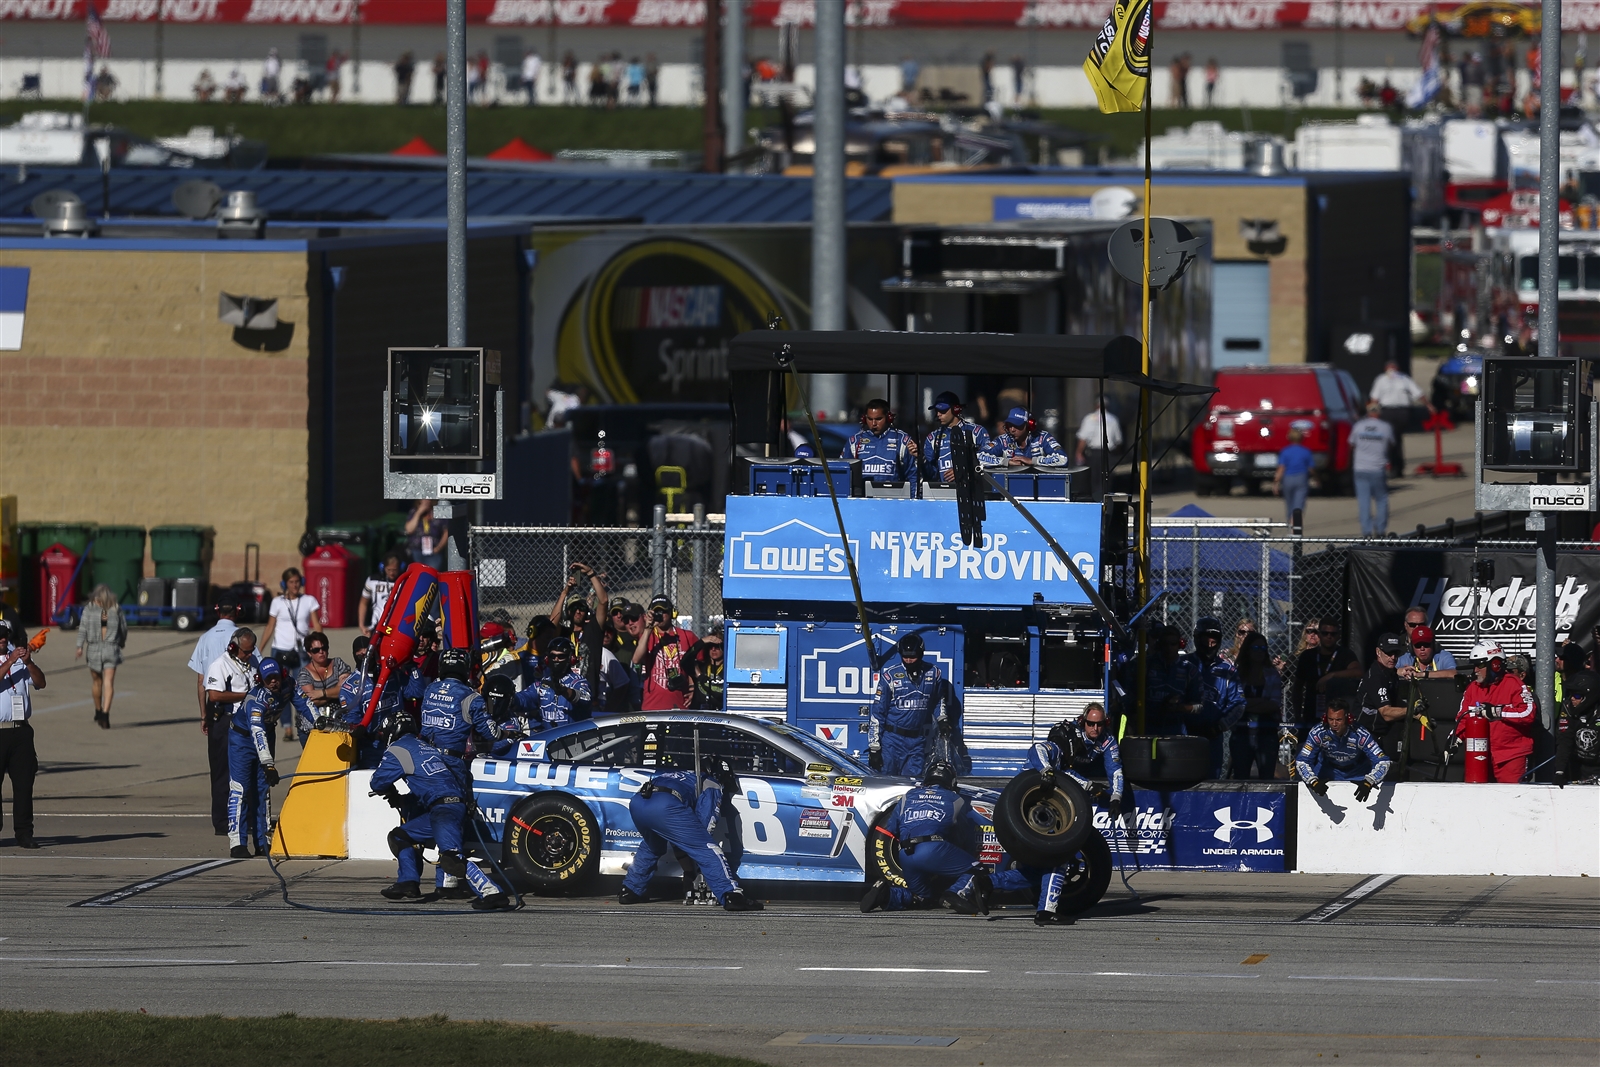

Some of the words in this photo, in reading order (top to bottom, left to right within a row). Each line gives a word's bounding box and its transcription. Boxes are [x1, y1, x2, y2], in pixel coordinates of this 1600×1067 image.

[649, 285, 723, 328] NASCAR
[863, 463, 893, 474] OWE'S
[870, 531, 944, 551] NEVER
[743, 541, 846, 573] LOWE'S
[890, 549, 1096, 582] IMPROVING
[429, 692, 454, 702] PATTON
[833, 785, 855, 795] Holley
[831, 794, 855, 808] 3M
[907, 809, 941, 820] LOWE'S
[1202, 847, 1237, 856] UNDER
[1240, 848, 1284, 857] ARMOUR
